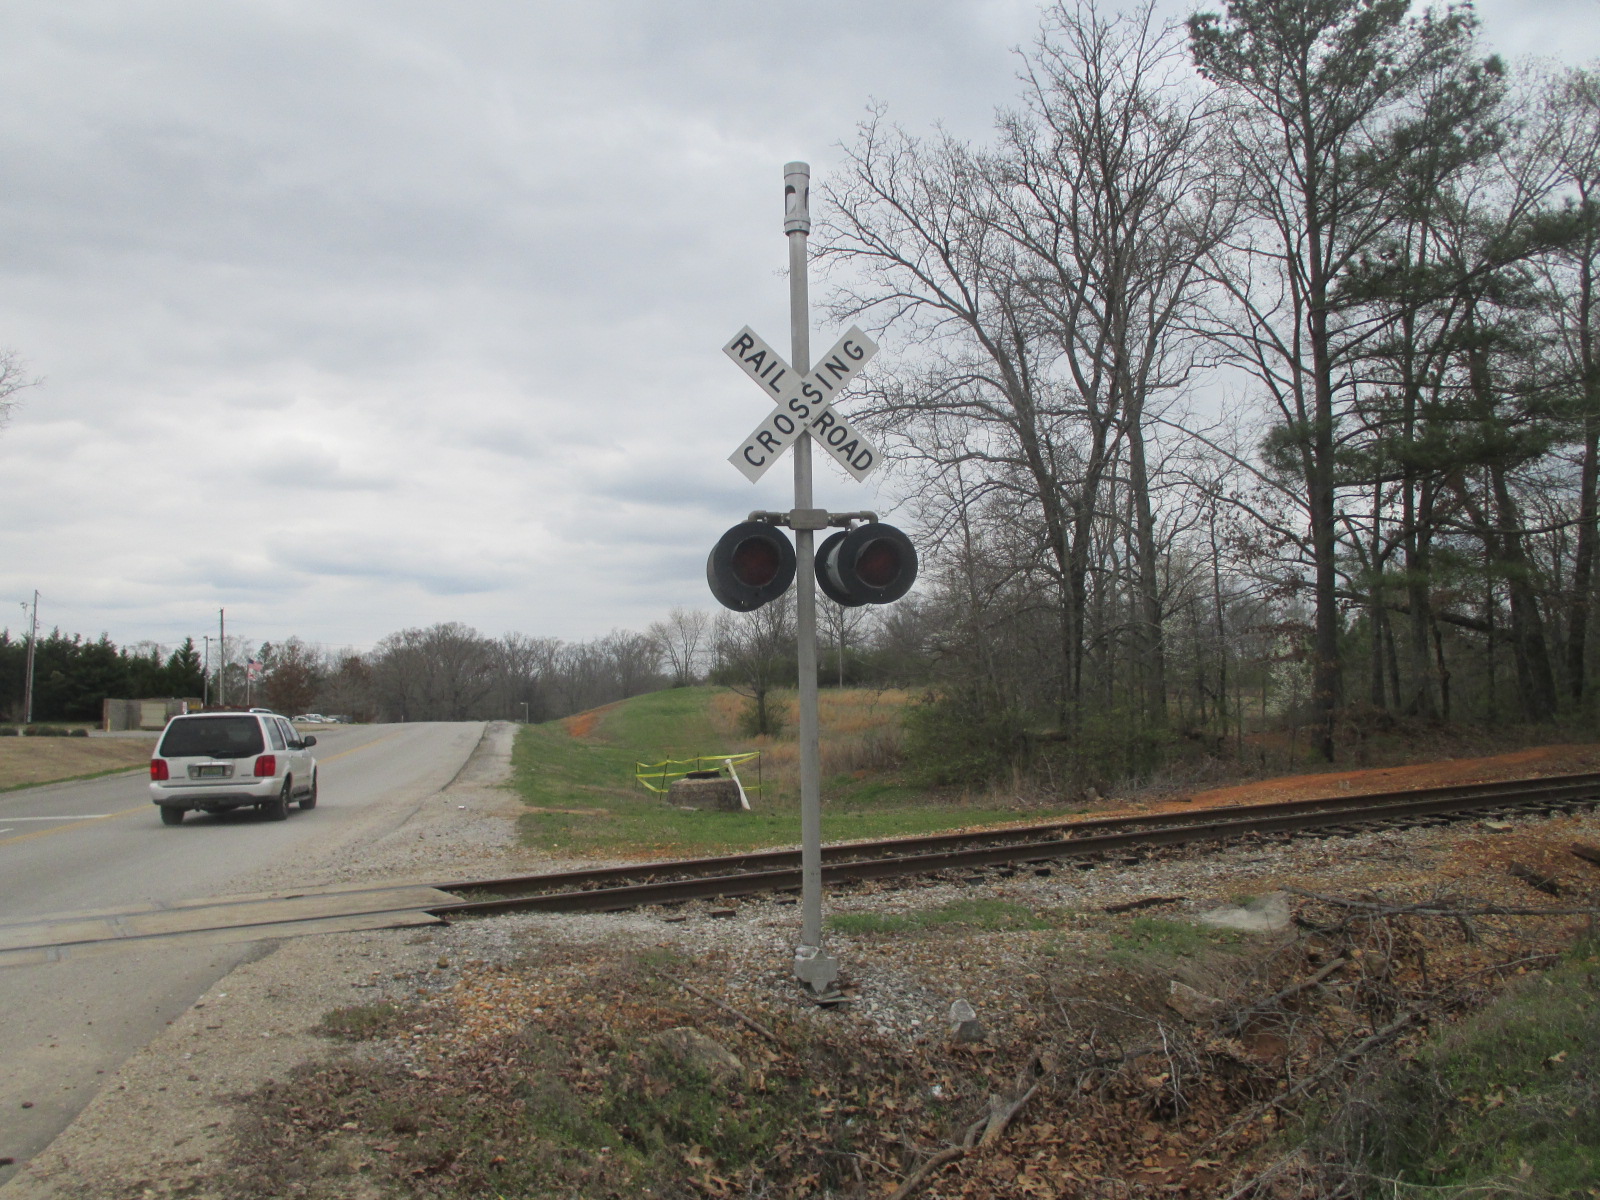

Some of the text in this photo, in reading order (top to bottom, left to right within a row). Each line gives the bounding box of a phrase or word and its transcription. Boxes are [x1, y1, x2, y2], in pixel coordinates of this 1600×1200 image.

[731, 332, 786, 393] RAIL
[743, 340, 864, 467] CROSSING
[811, 410, 873, 471] ROAD
